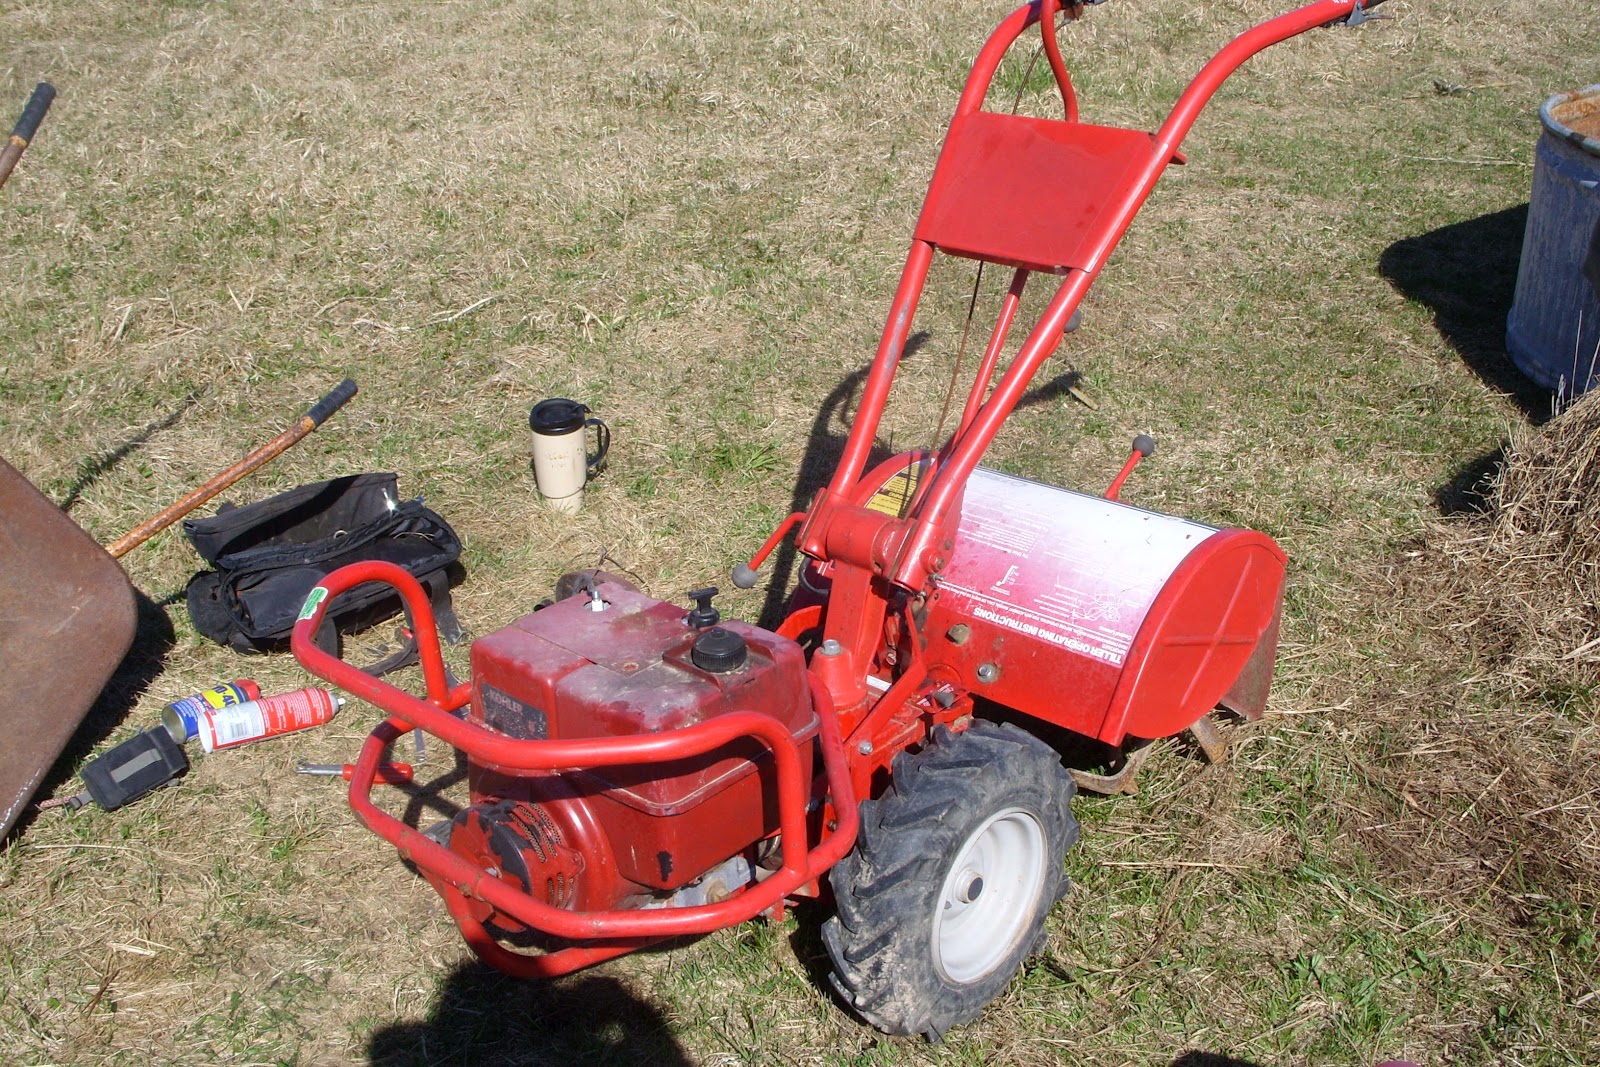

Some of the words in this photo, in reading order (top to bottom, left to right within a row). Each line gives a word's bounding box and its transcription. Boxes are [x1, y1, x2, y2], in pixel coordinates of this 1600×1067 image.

[973, 607, 1038, 635] INSTRUCTIONS
[1038, 628, 1090, 653] OPERATING
[1090, 646, 1121, 664] TILLER
[489, 689, 523, 714] KOHLER
